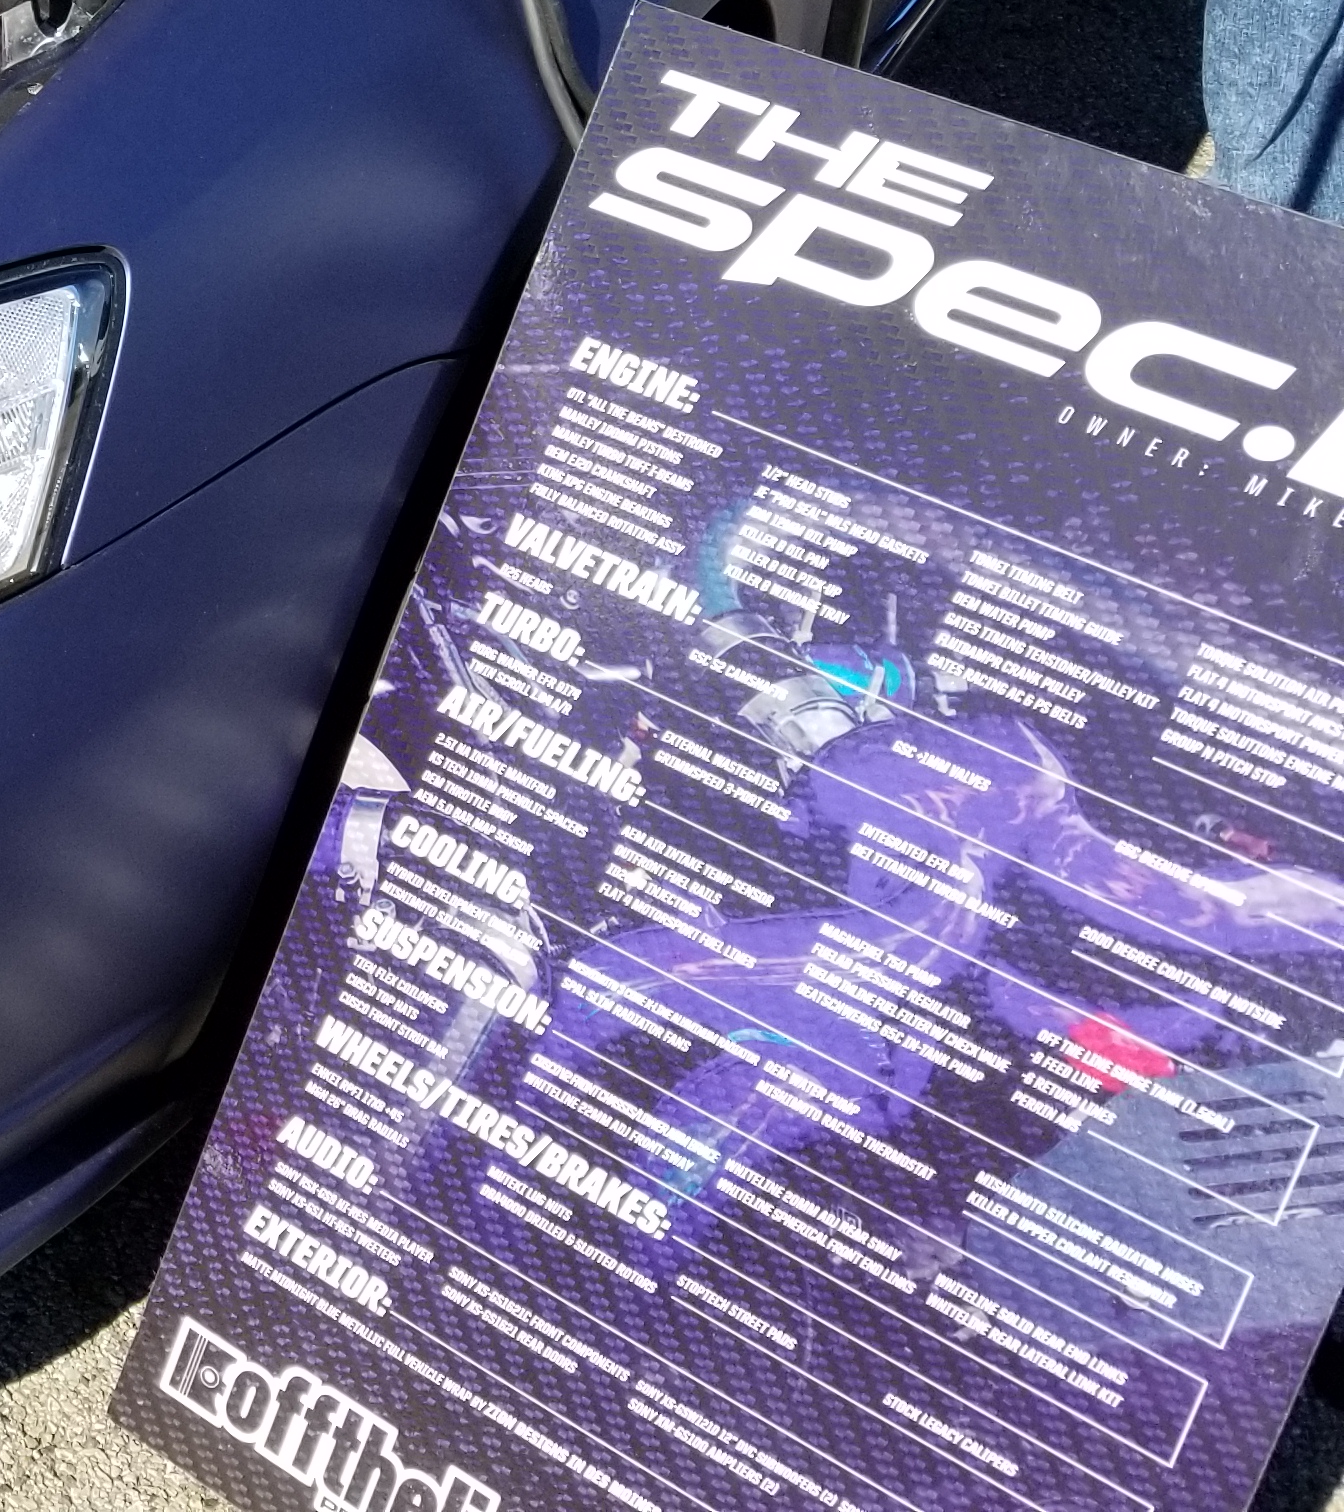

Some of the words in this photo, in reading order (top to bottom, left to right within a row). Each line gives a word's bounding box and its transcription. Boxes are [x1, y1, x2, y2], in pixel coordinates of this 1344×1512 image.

[660, 69, 995, 227] THE
[568, 335, 705, 414] ENGINE:
[1058, 405, 1211, 478] OWNER:
[502, 513, 708, 625] VALVETRAIN:
[654, 535, 685, 556] ASSY
[474, 592, 591, 667] TURBO:
[1052, 583, 1085, 606] BELT
[926, 652, 965, 677] GATES
[961, 667, 1010, 696] RACING
[1031, 697, 1053, 715] PS
[1048, 704, 1088, 730] BELTS
[943, 611, 982, 636] GATES
[978, 626, 1027, 655] TIMING
[1132, 690, 1160, 711] KIT
[1000, 659, 1044, 687] CRANK
[1039, 676, 1086, 704] PULLEY
[434, 680, 653, 809] AIR/FUELING:
[1159, 727, 1205, 756] GROUP
[1210, 749, 1255, 777] PITCH
[1249, 765, 1288, 791] STOP
[1168, 707, 1220, 737] TORQUE
[1215, 726, 1287, 766] SOLUTIONS
[1282, 754, 1335, 786] ENGINE
[388, 813, 536, 909] COOLING:
[662, 845, 705, 873] INTAKE
[701, 864, 735, 888] TEMP
[730, 878, 776, 908] SENSOR
[353, 906, 557, 1035] SUSPENSION:
[1110, 940, 1160, 972] DEGREE
[1155, 961, 1213, 996] COATING
[1208, 985, 1231, 1005] ON
[274, 1113, 384, 1194] AUDIO:
[312, 1015, 679, 1240] WHEELS/TIRES/BRAKES:
[819, 1113, 865, 1144] RACING
[861, 1135, 938, 1182] THERMOSTAT
[242, 1204, 398, 1316] EXTERIOR:
[675, 1274, 731, 1313] STOPTECH
[726, 1303, 771, 1335] STREET
[766, 1325, 799, 1351] PADS
[1017, 1343, 1070, 1379] LATERAL
[1096, 1386, 1125, 1409] KIT
[881, 1392, 922, 1422] STOCK
[918, 1412, 964, 1446] LEGACY
[959, 1435, 1020, 1477] CALIPERS
